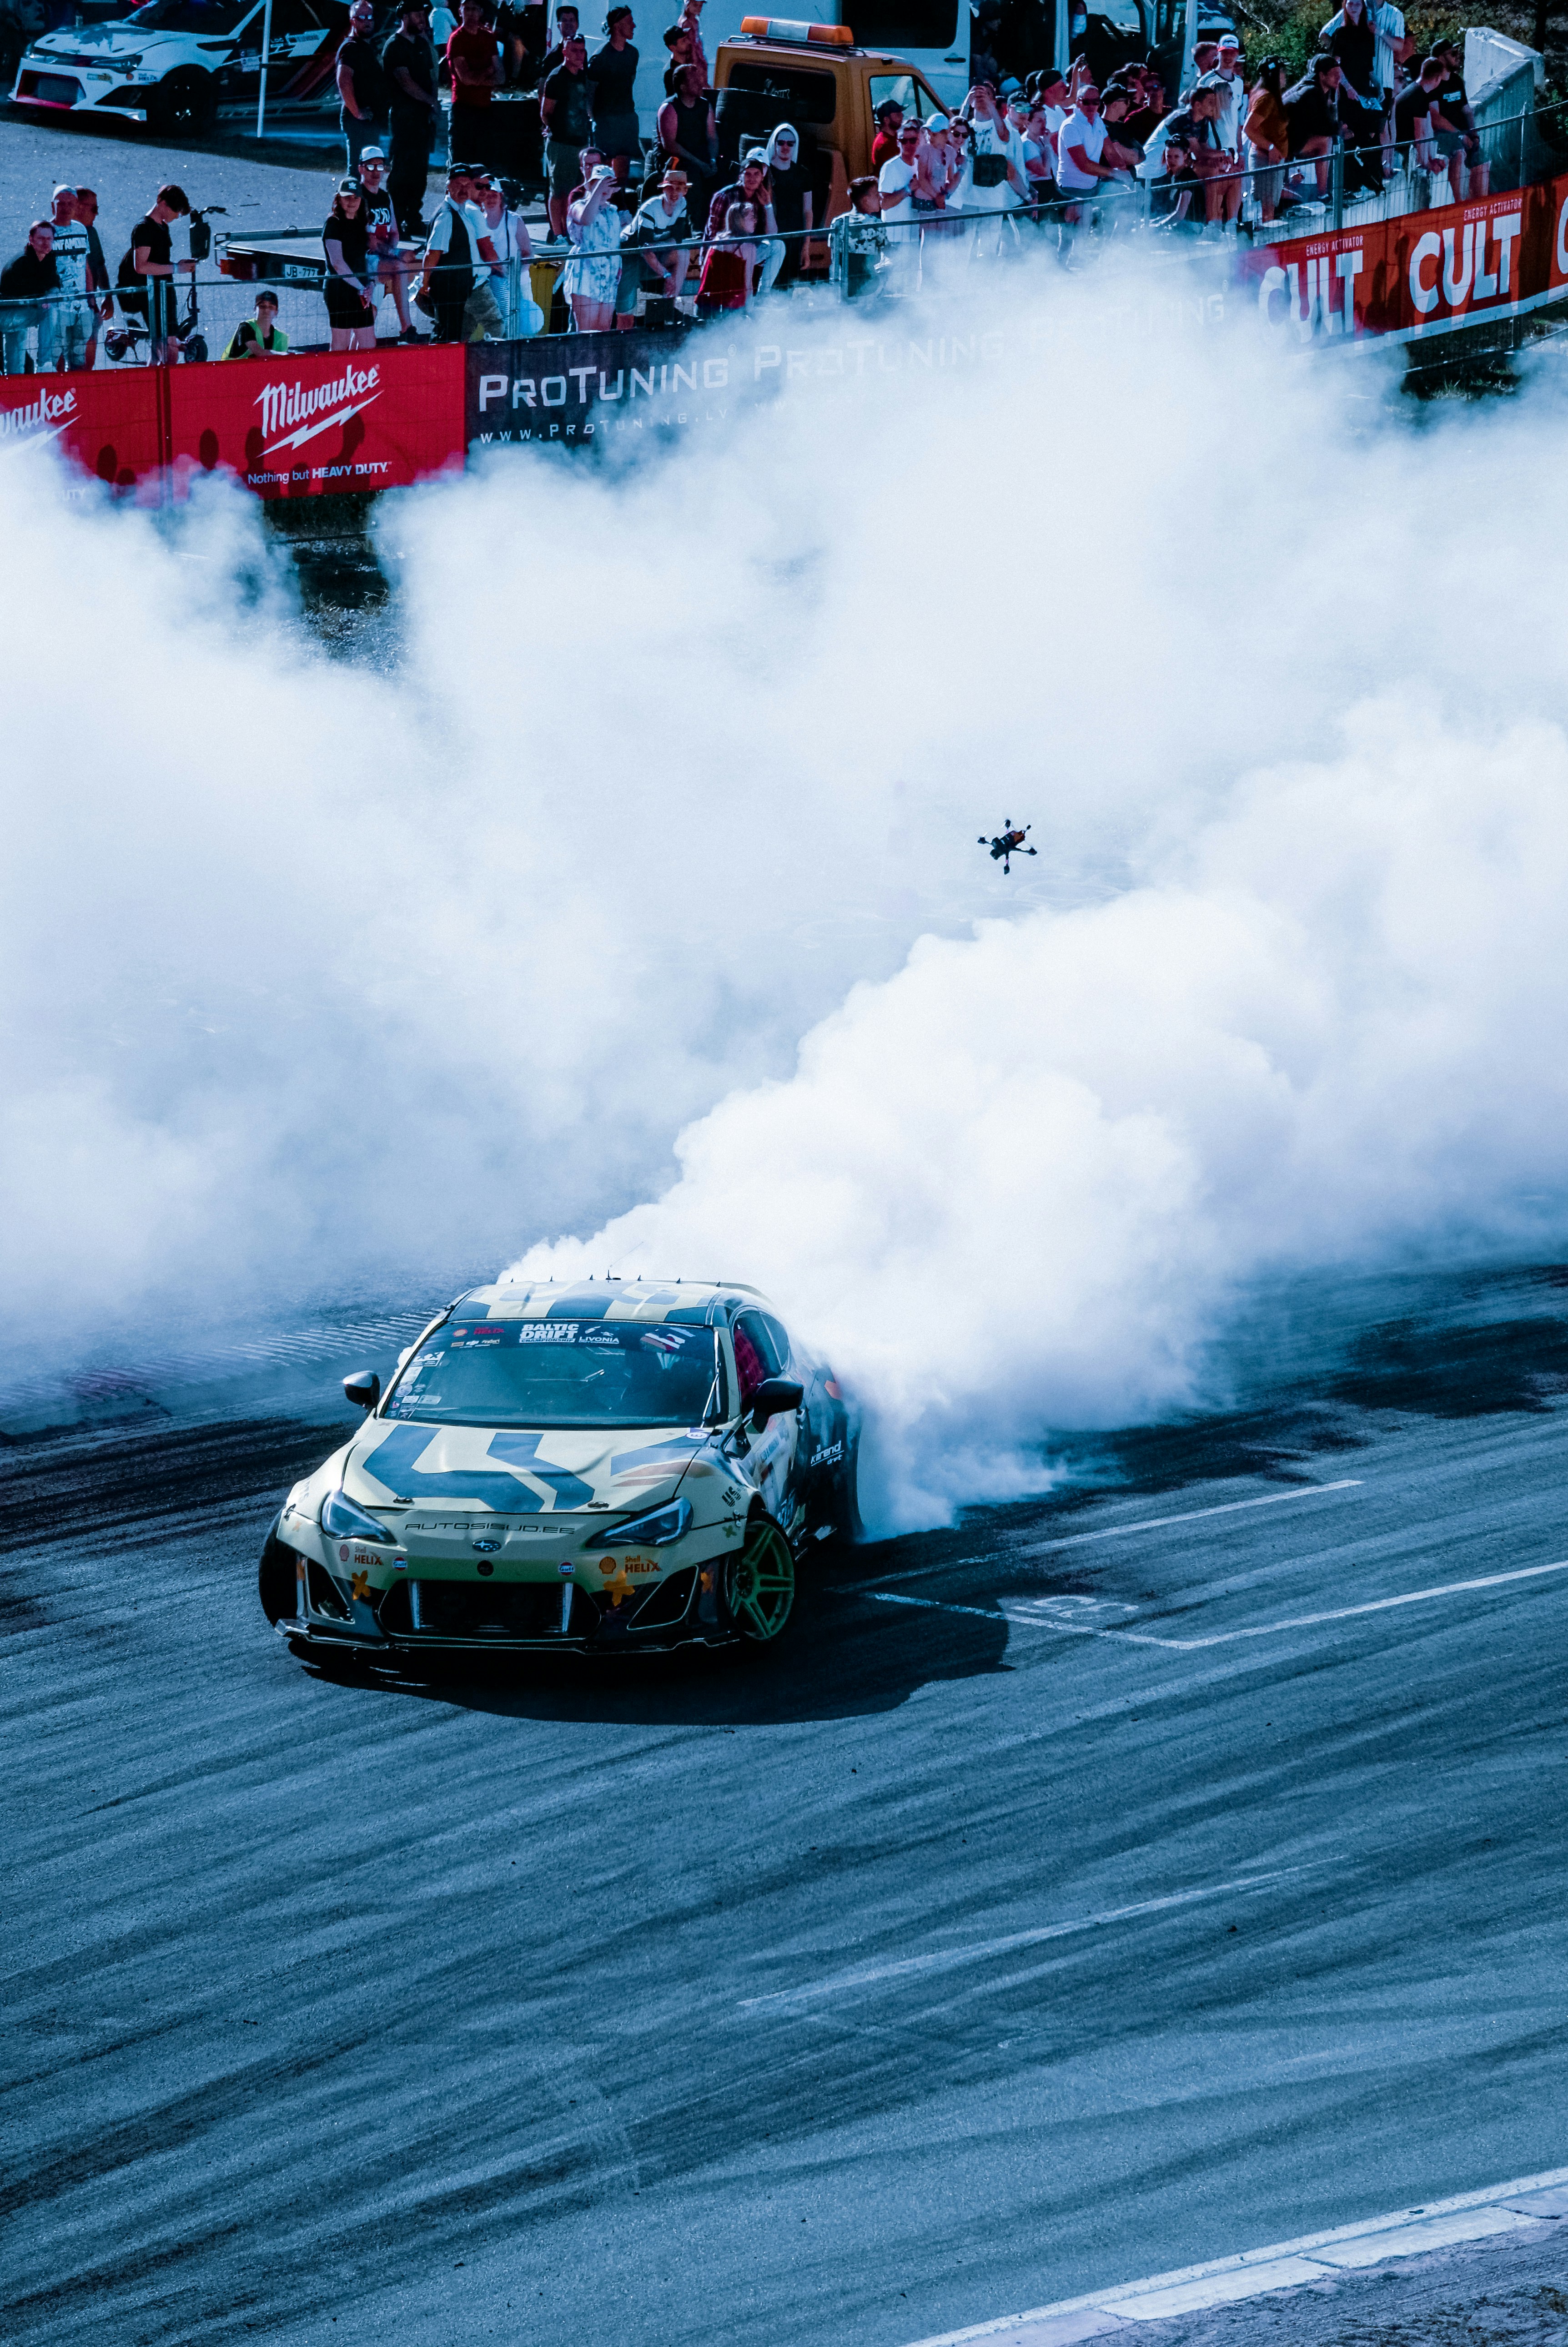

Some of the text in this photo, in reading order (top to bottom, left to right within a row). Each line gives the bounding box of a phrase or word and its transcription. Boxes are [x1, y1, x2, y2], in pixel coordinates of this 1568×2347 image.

[1464, 198, 1522, 221] ENERGY ACTIVATOR
[1306, 235, 1363, 256] ENERGY ACTIVATOR
[1410, 212, 1521, 314] CULT
[1259, 250, 1363, 344] CULT
[252, 365, 381, 439] Milwaukee
[248, 472, 290, 485] Nothing
[292, 469, 310, 481] but
[312, 465, 352, 479] HEAVY
[520, 1330, 578, 1339] DRIFT
[354, 1552, 384, 1566] HELIX
[625, 1560, 662, 1573] HELIX
